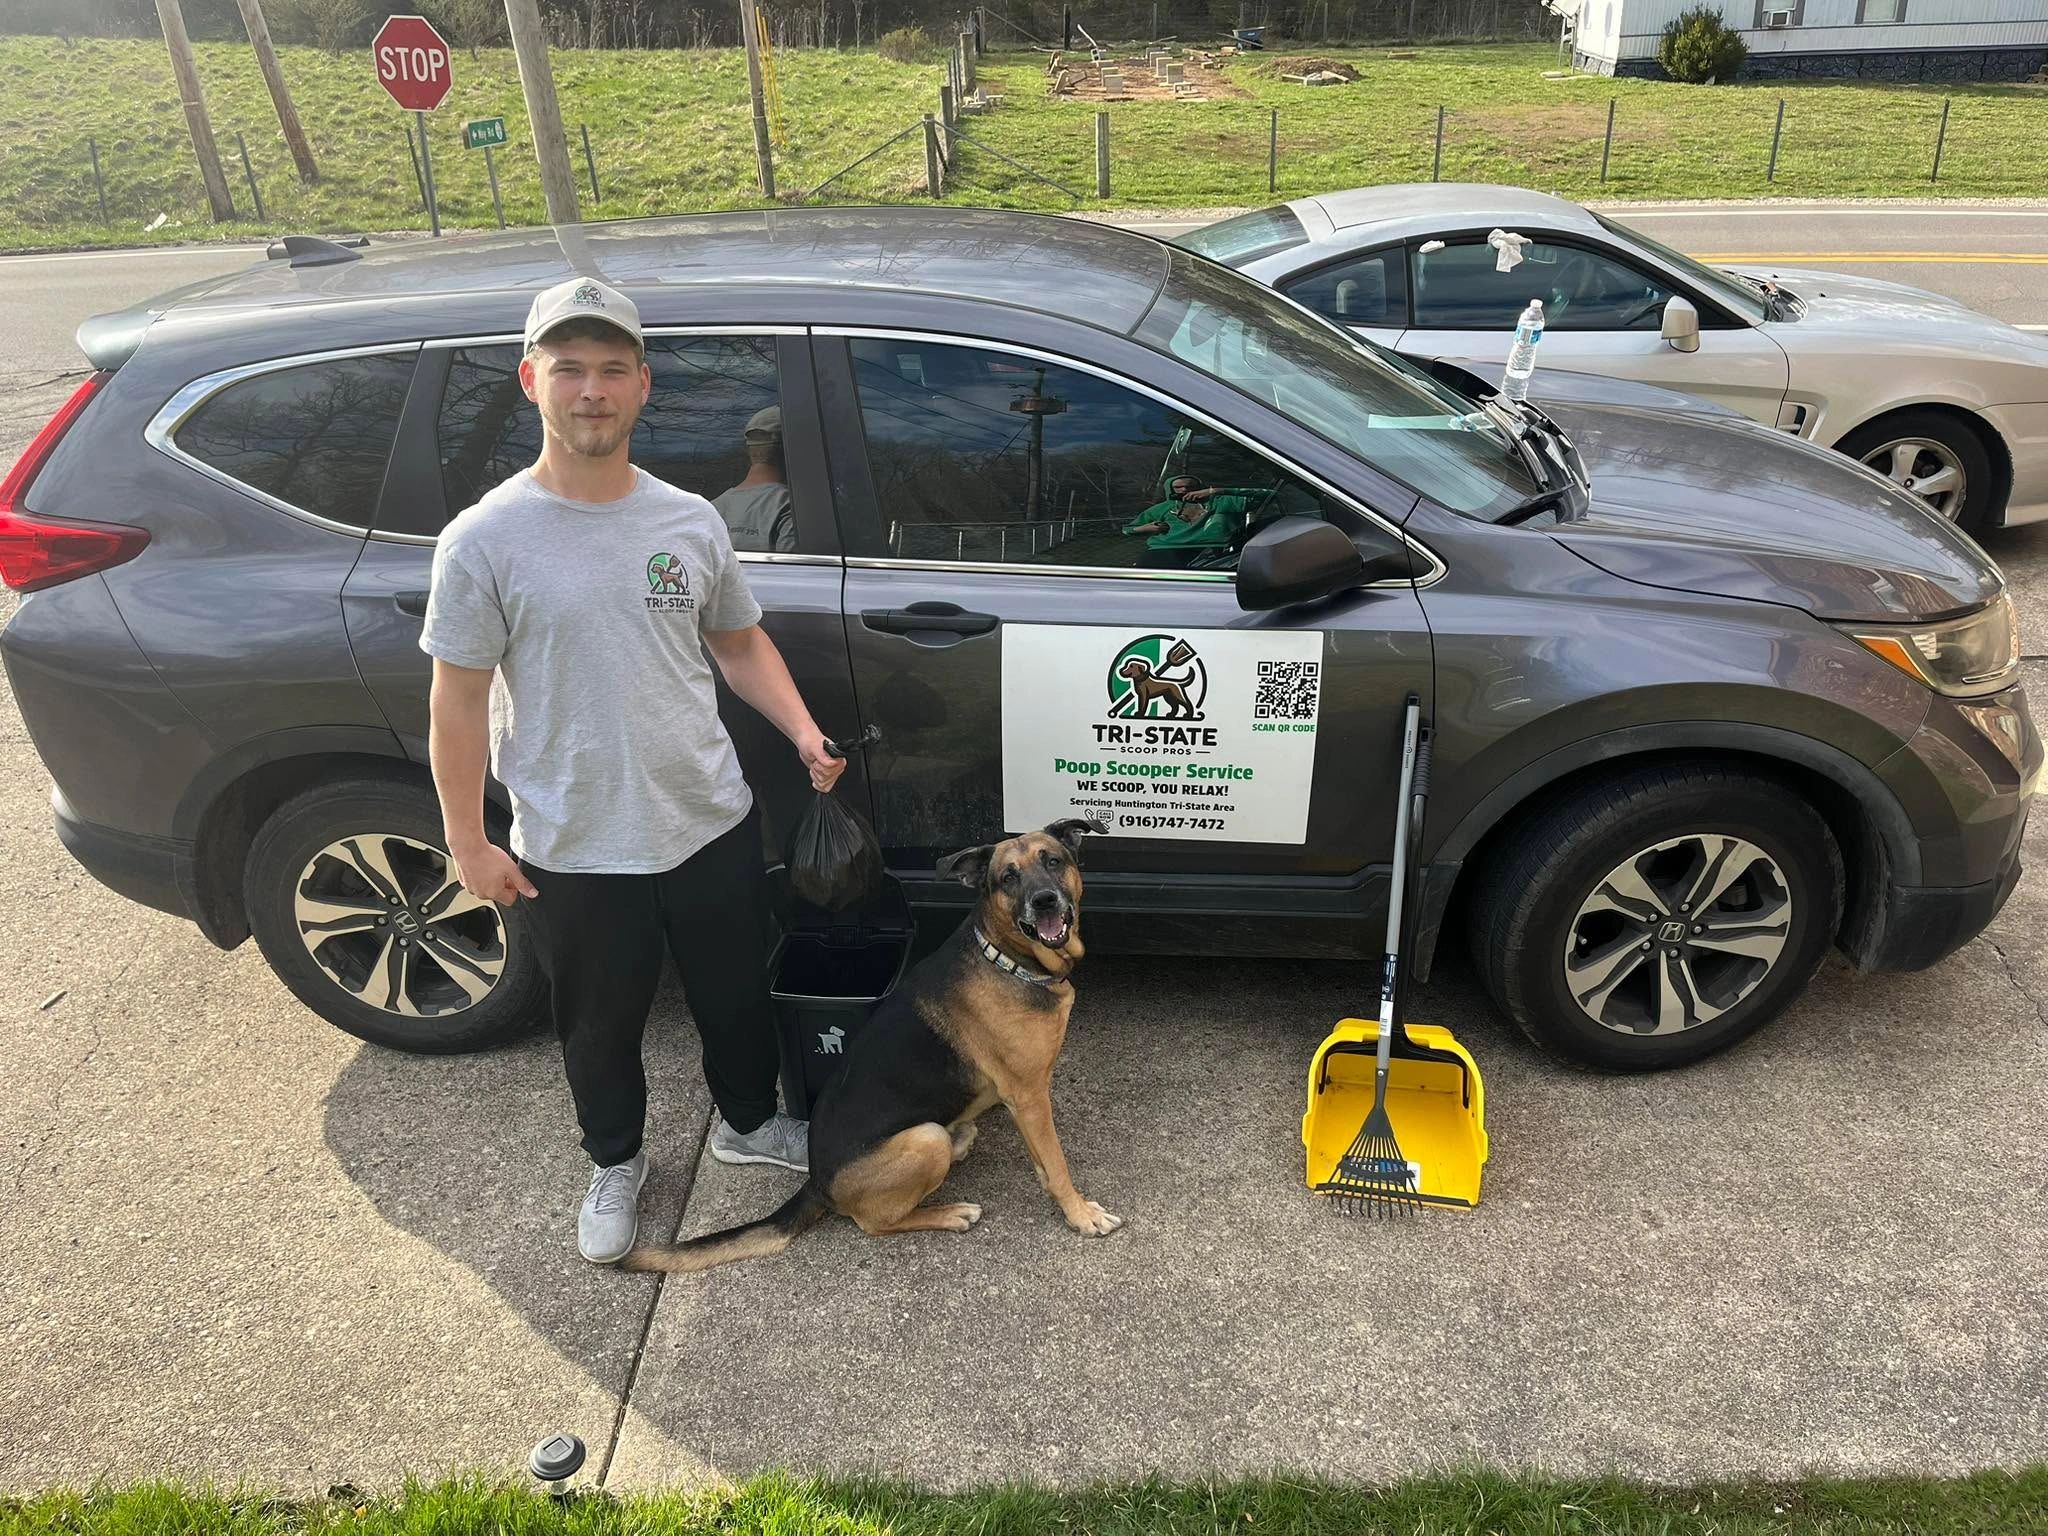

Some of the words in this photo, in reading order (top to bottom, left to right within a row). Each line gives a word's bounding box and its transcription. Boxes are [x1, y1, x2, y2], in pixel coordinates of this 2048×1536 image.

[380, 46, 445, 82] STOP
[644, 597, 695, 609] TRI-STATE
[1091, 724, 1218, 747] TRI-STATE
[1252, 723, 1276, 732] SCAN
[1278, 724, 1290, 733] QR
[1292, 724, 1316, 733] CODE
[1120, 746, 1158, 755] SCOOP
[1162, 747, 1192, 756] PROS
[1054, 758, 1101, 777] Poop
[1106, 760, 1181, 780] Scooper
[1186, 763, 1254, 780] Service
[1076, 780, 1098, 792] WE
[1101, 781, 1147, 795] SCOOP,
[1152, 783, 1178, 795] YOU
[1181, 784, 1229, 797] RELAX!
[1069, 797, 1113, 808] Servicing
[1114, 799, 1168, 810] Huntington
[1170, 801, 1211, 812] Tri-State
[1213, 803, 1236, 813] Area
[1119, 814, 1226, 831] (916)747-7472
